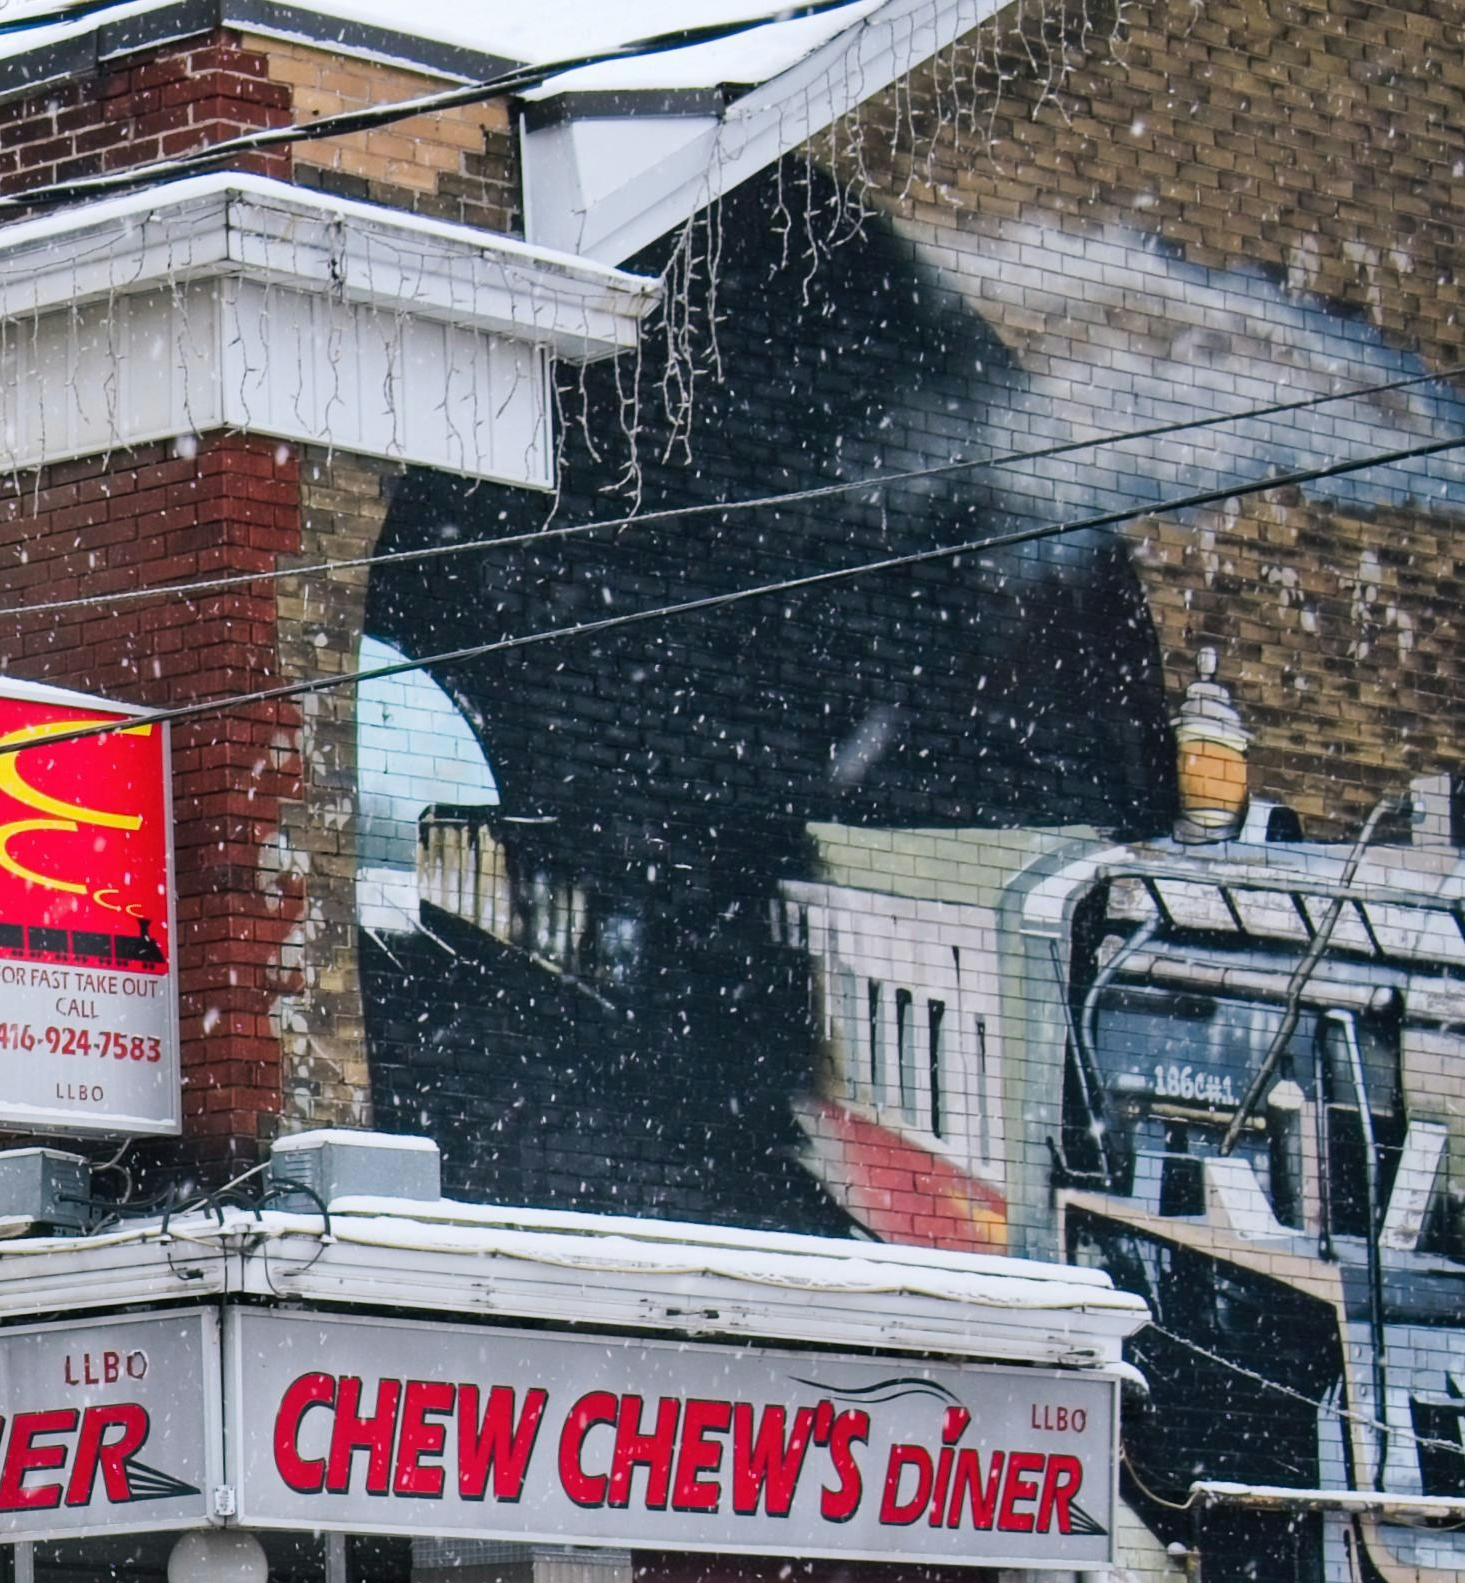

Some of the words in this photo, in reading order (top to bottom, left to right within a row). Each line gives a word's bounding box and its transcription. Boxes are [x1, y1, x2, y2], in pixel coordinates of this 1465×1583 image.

[30, 969, 70, 991] FAST
[74, 973, 118, 995] TAKE
[122, 977, 159, 999] OUT
[55, 997, 99, 1019] CALL
[56, 1083, 105, 1102] LLBO
[65, 1352, 149, 1387] LLBO
[1031, 1402, 1086, 1433] LLBO
[273, 1370, 549, 1502] CHEW
[558, 1391, 870, 1525] CHEW'S
